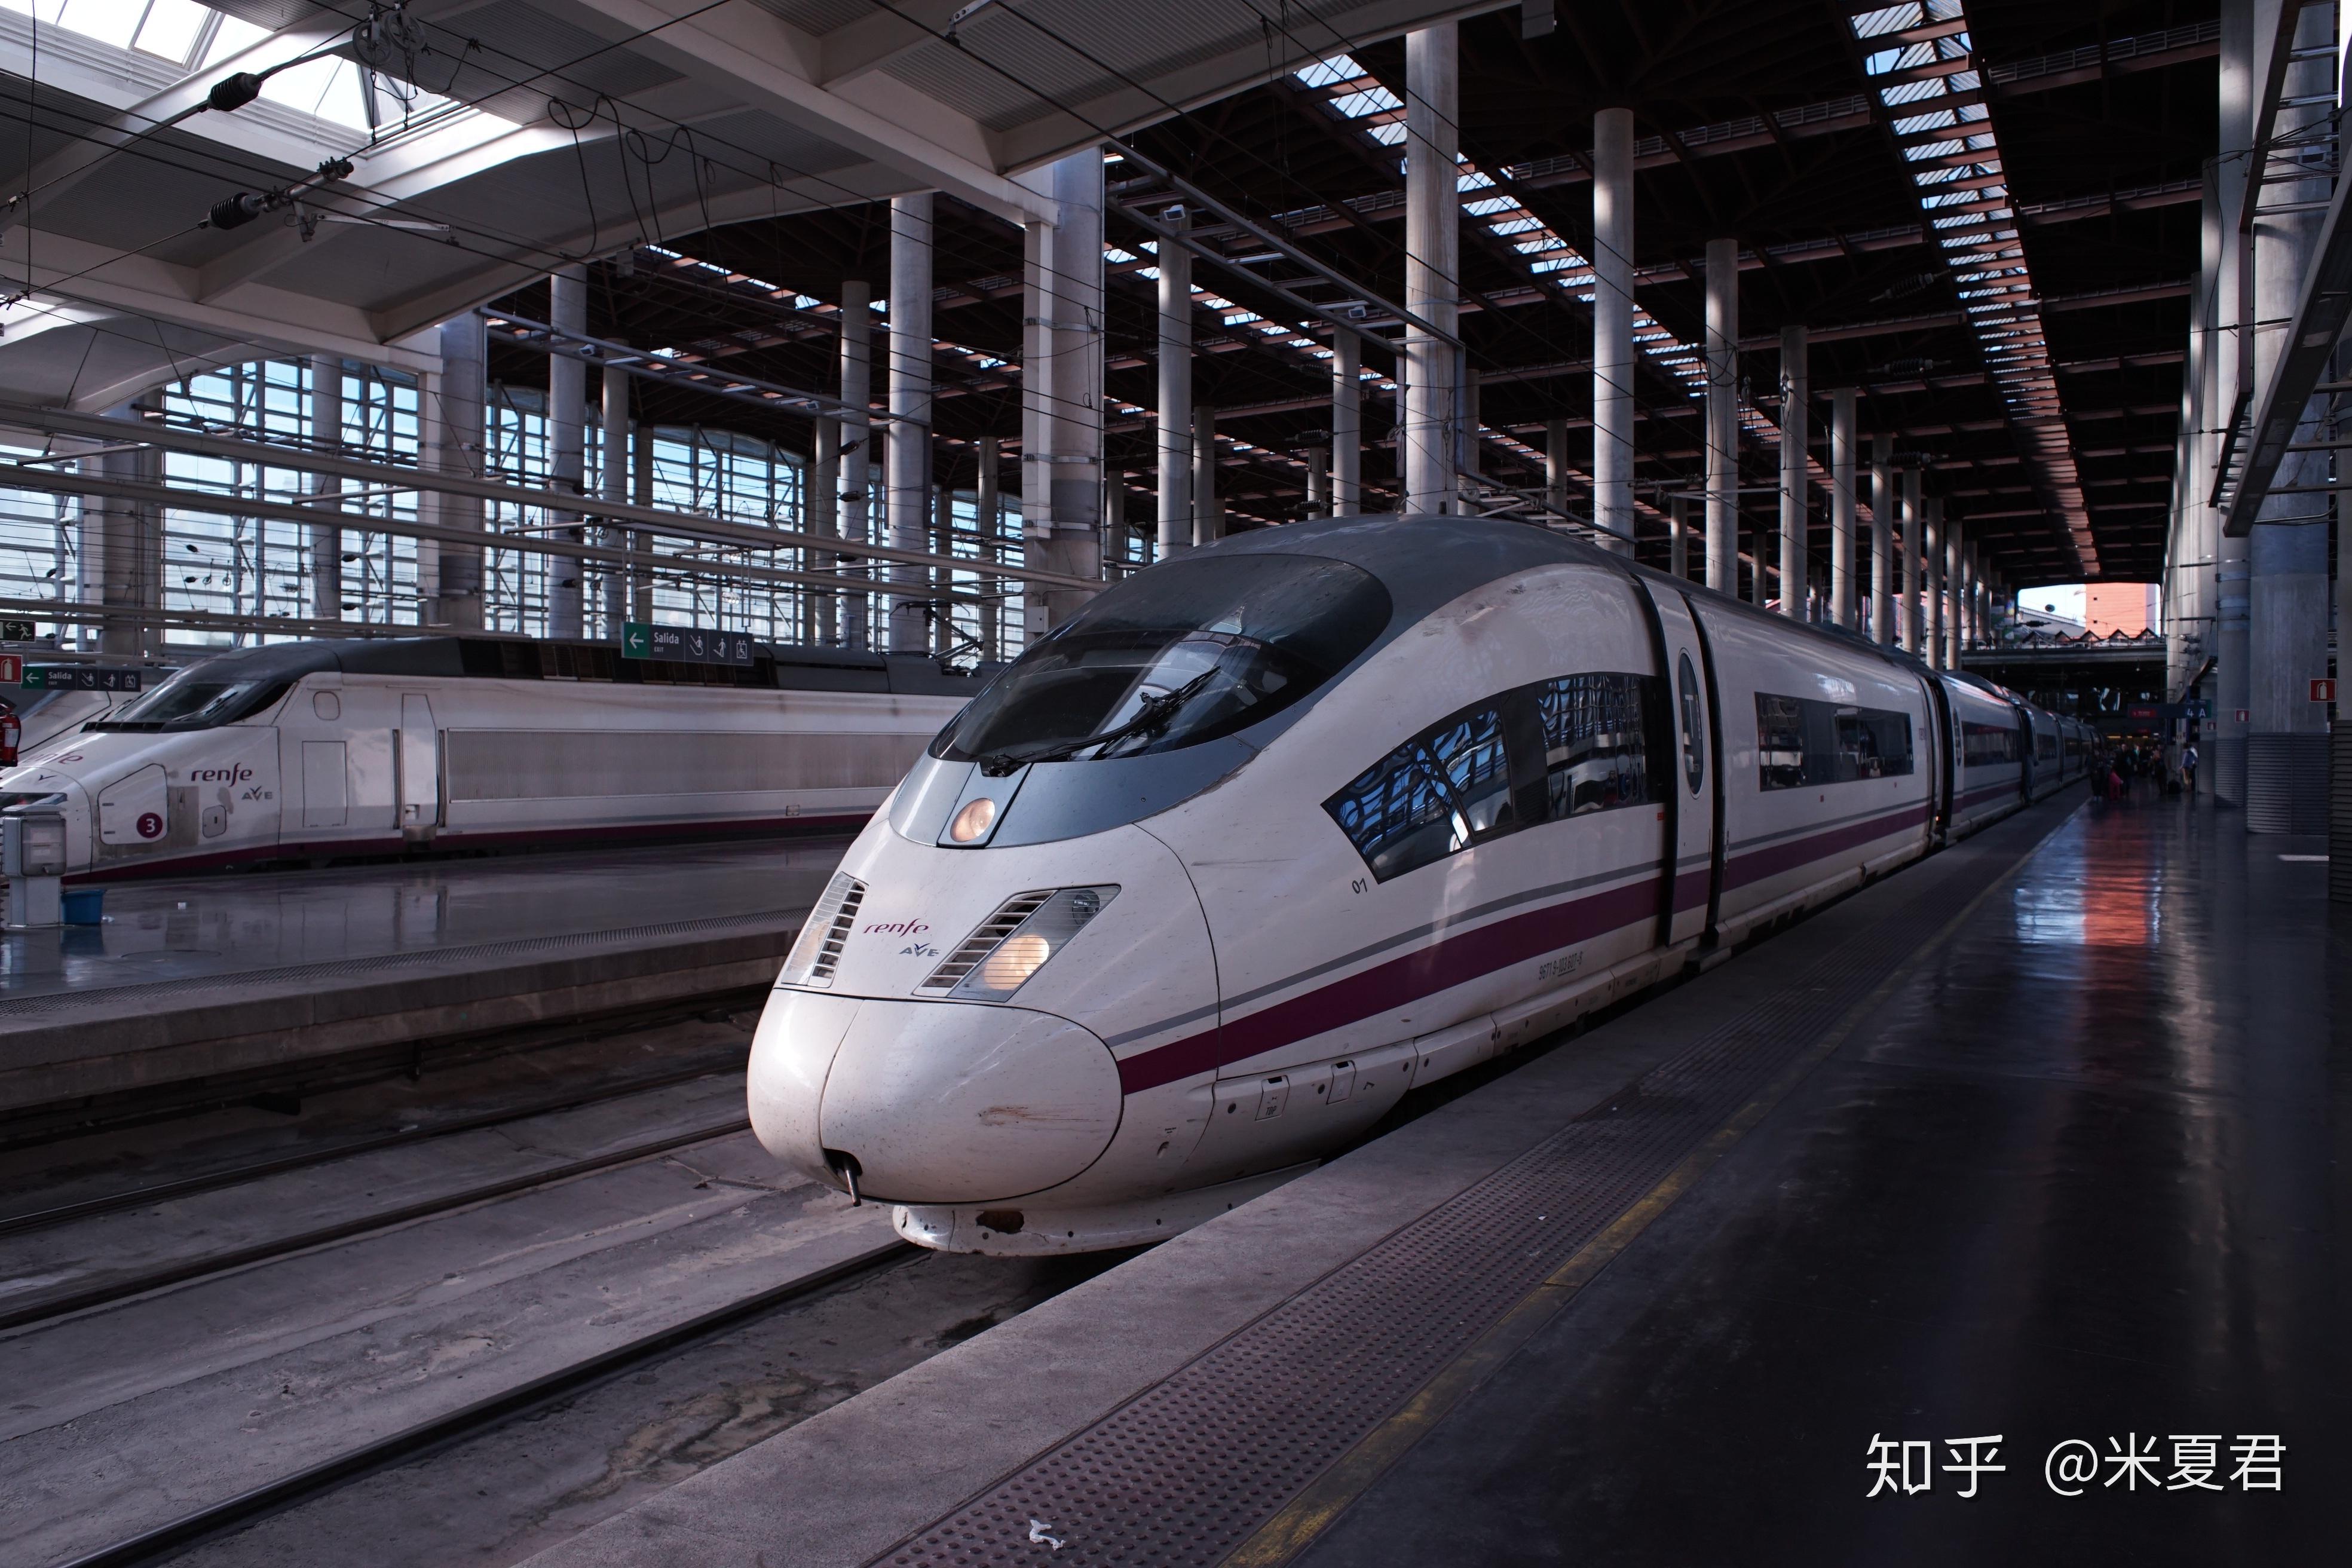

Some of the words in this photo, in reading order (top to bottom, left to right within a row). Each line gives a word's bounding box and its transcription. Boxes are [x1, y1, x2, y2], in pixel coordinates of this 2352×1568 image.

[654, 632, 679, 644] Salida
[48, 672, 72, 680] Salida
[191, 762, 252, 788] renfe
[241, 786, 273, 801] AVE
[146, 818, 155, 832] 3
[1352, 877, 1368, 894] 01
[863, 918, 929, 938] renfe
[899, 942, 940, 957] AVE
